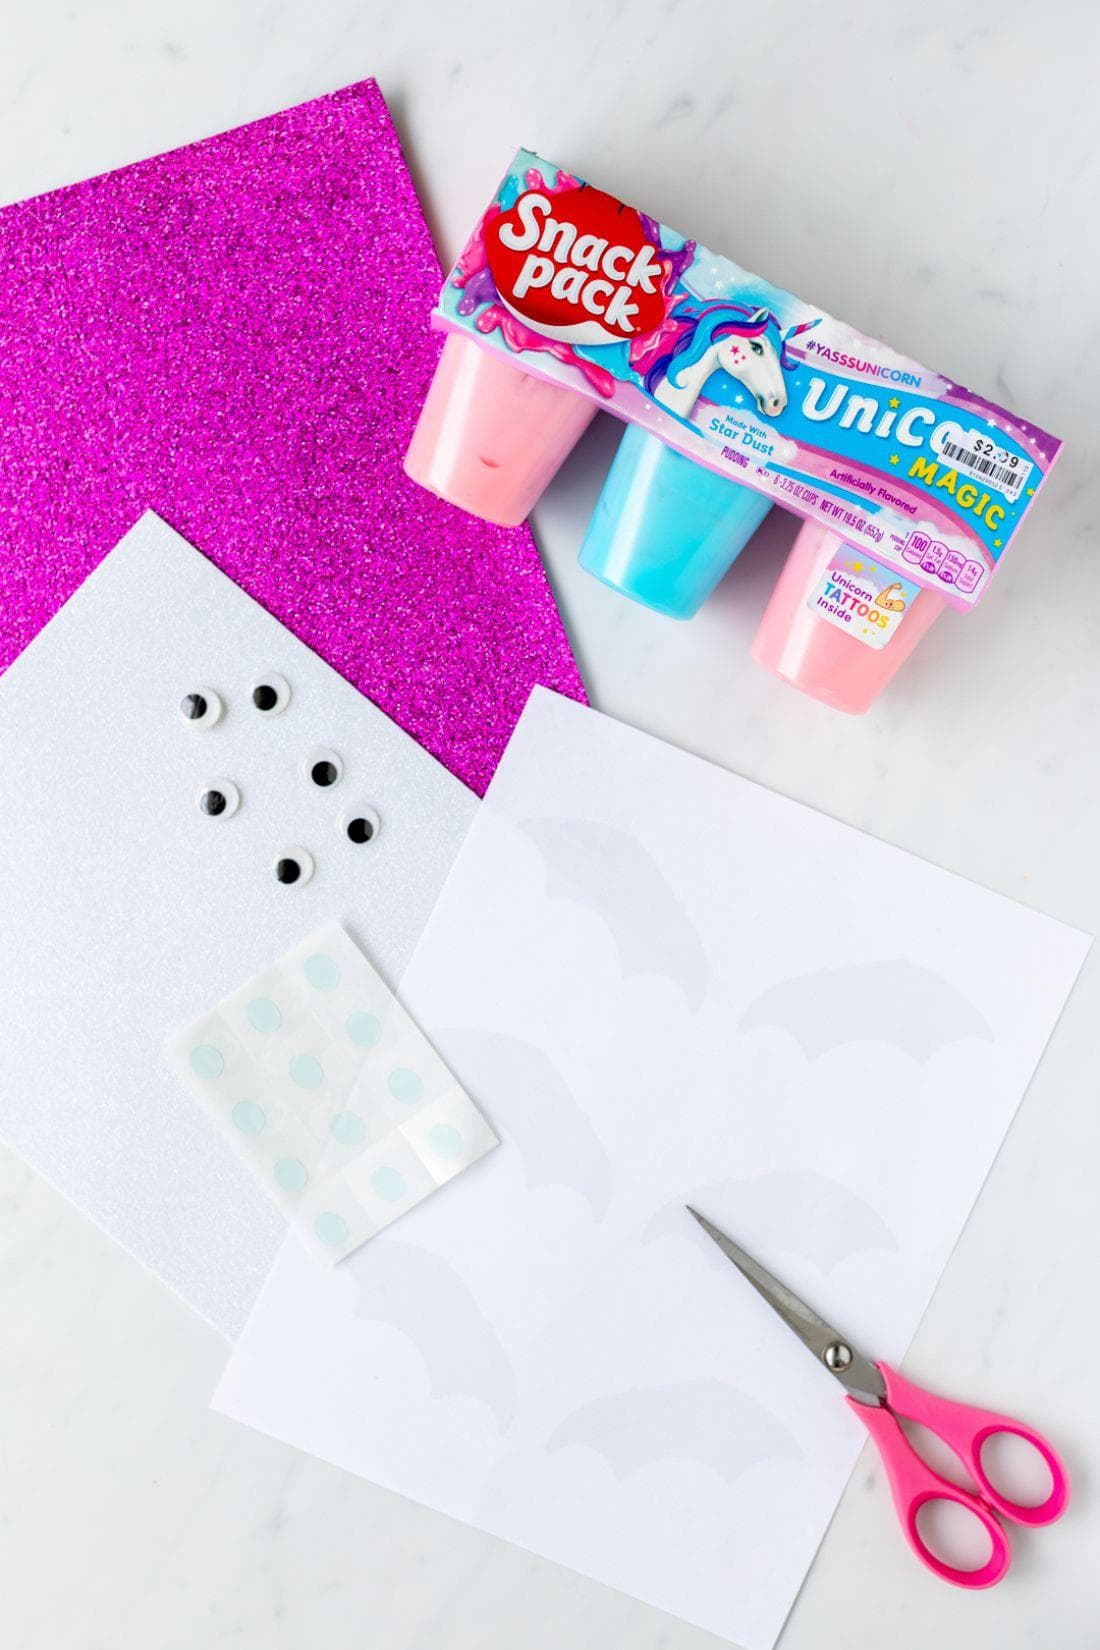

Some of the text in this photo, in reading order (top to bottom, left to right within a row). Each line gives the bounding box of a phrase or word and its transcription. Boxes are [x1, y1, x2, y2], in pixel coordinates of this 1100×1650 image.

[499, 193, 662, 294] Snack
[512, 254, 639, 332] pack
[806, 339, 922, 388] #YASSSUNICORN
[709, 418, 775, 457] Star Dust
[725, 415, 768, 440] Made With
[720, 445, 750, 468] PUDDING
[793, 485, 804, 498] OZ
[802, 489, 819, 506] CUPS
[829, 469, 918, 514] Artificially Flavored
[908, 456, 1006, 531] MAGIC
[820, 499, 833, 513] NET
[831, 505, 845, 519] WT
[842, 511, 857, 527] 19.5
[855, 518, 867, 532] OZ
[911, 535, 928, 552] 100
[831, 571, 873, 602] Unicorn
[816, 596, 852, 622] Inside
[824, 582, 889, 629] TATTOOS
